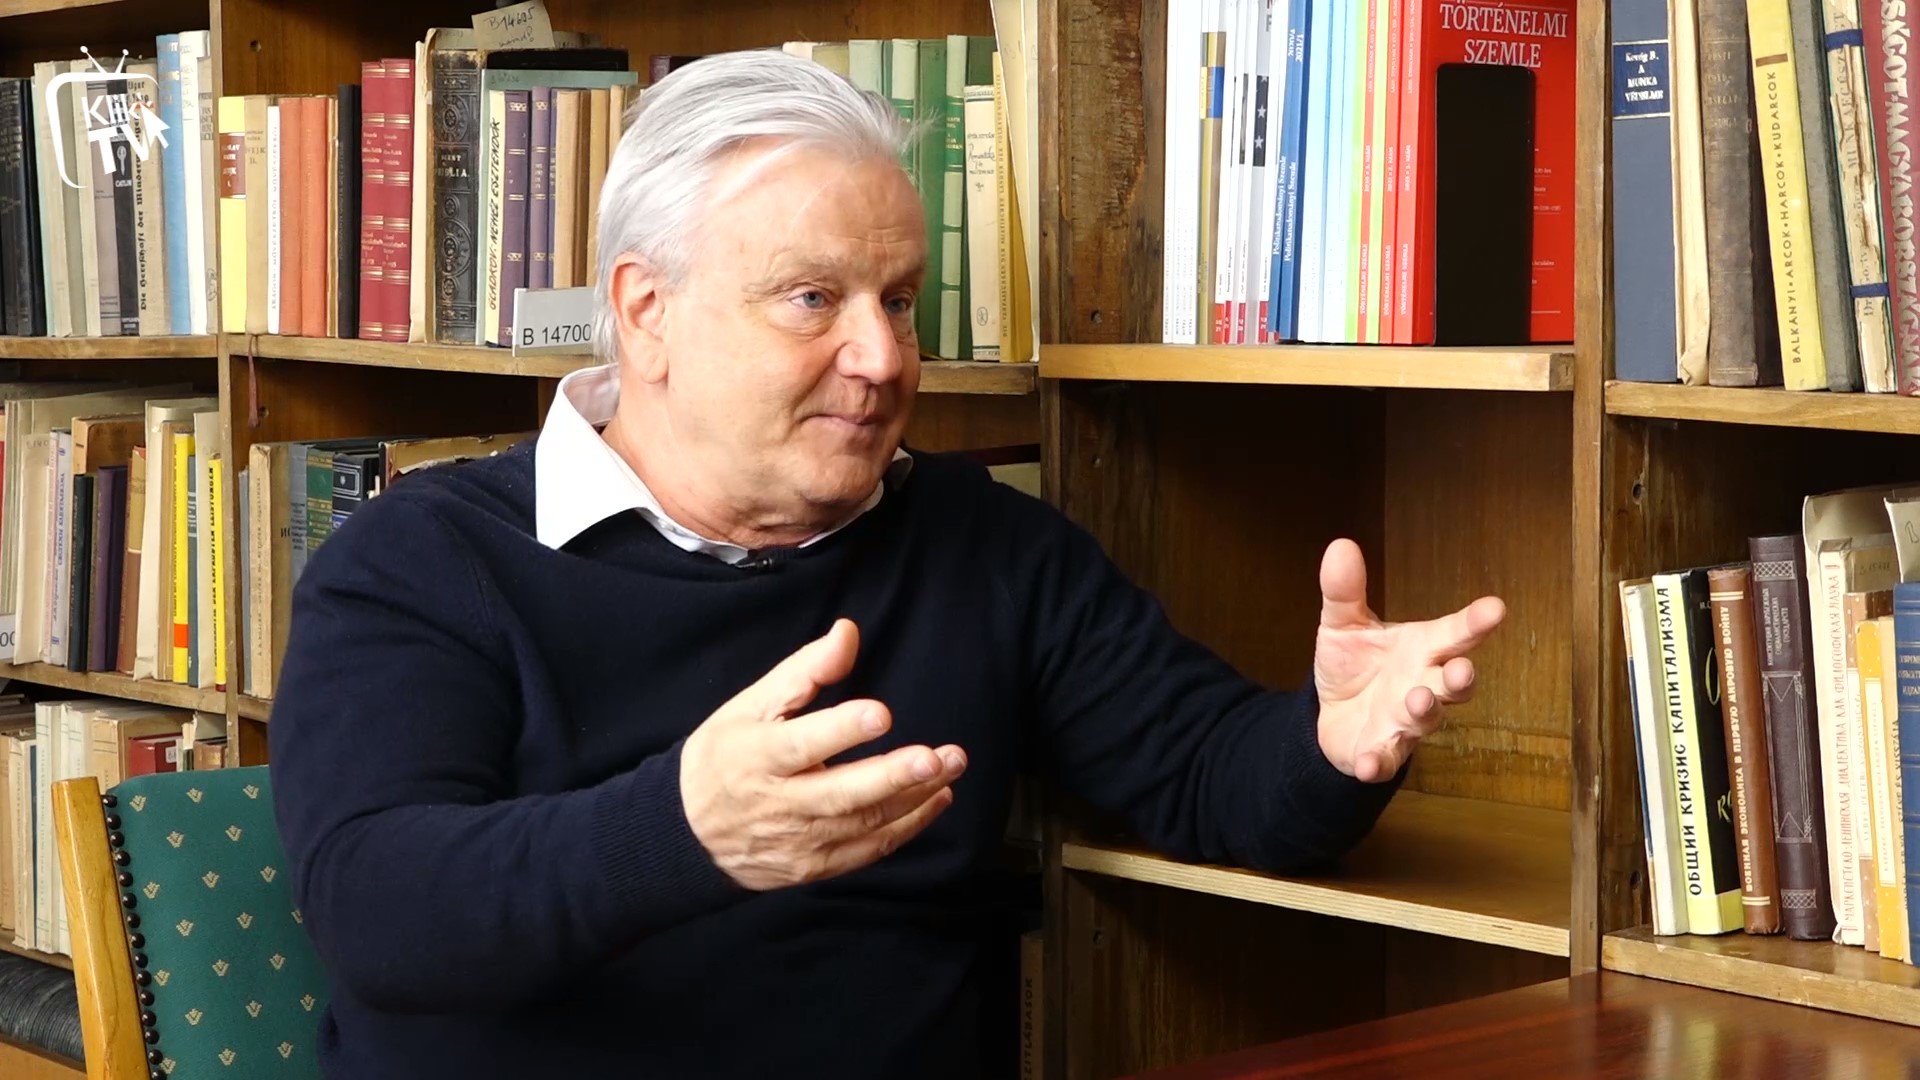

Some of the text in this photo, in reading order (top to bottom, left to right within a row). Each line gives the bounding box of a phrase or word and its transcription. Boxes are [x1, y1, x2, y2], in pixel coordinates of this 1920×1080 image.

[1439, 0, 1568, 38] TÖRTÉNELMI
[1295, 33, 1304, 63] 2021/1
[1463, 38, 1541, 68] SZEMLE
[1627, 76, 1658, 88] MUNKA
[1638, 64, 1645, 74] A
[1767, 71, 1782, 150] KUDARCOK
[1277, 156, 1287, 184] Szemle
[1776, 160, 1789, 220] HARCOK
[136, 210, 145, 228] der
[1782, 230, 1794, 279] ARCOK
[139, 292, 148, 311] Die
[523, 323, 592, 345] B 14700
[1828, 575, 1841, 609] НАУКА
[1829, 612, 1845, 693] ФИЛОСОФСКАЯ
[1834, 697, 1846, 718] КАК
[1656, 586, 1702, 896] ОБЩИЙ КРИЗИС КАПИТАЛИЗМА
[1720, 606, 1752, 892] ВОЕННАЯ ЭКОНОМИКА В ПЕРВУЮ МИРОВУЮ ВОЙНУ
[1835, 723, 1849, 787] ДИАЛЕКТИКА
